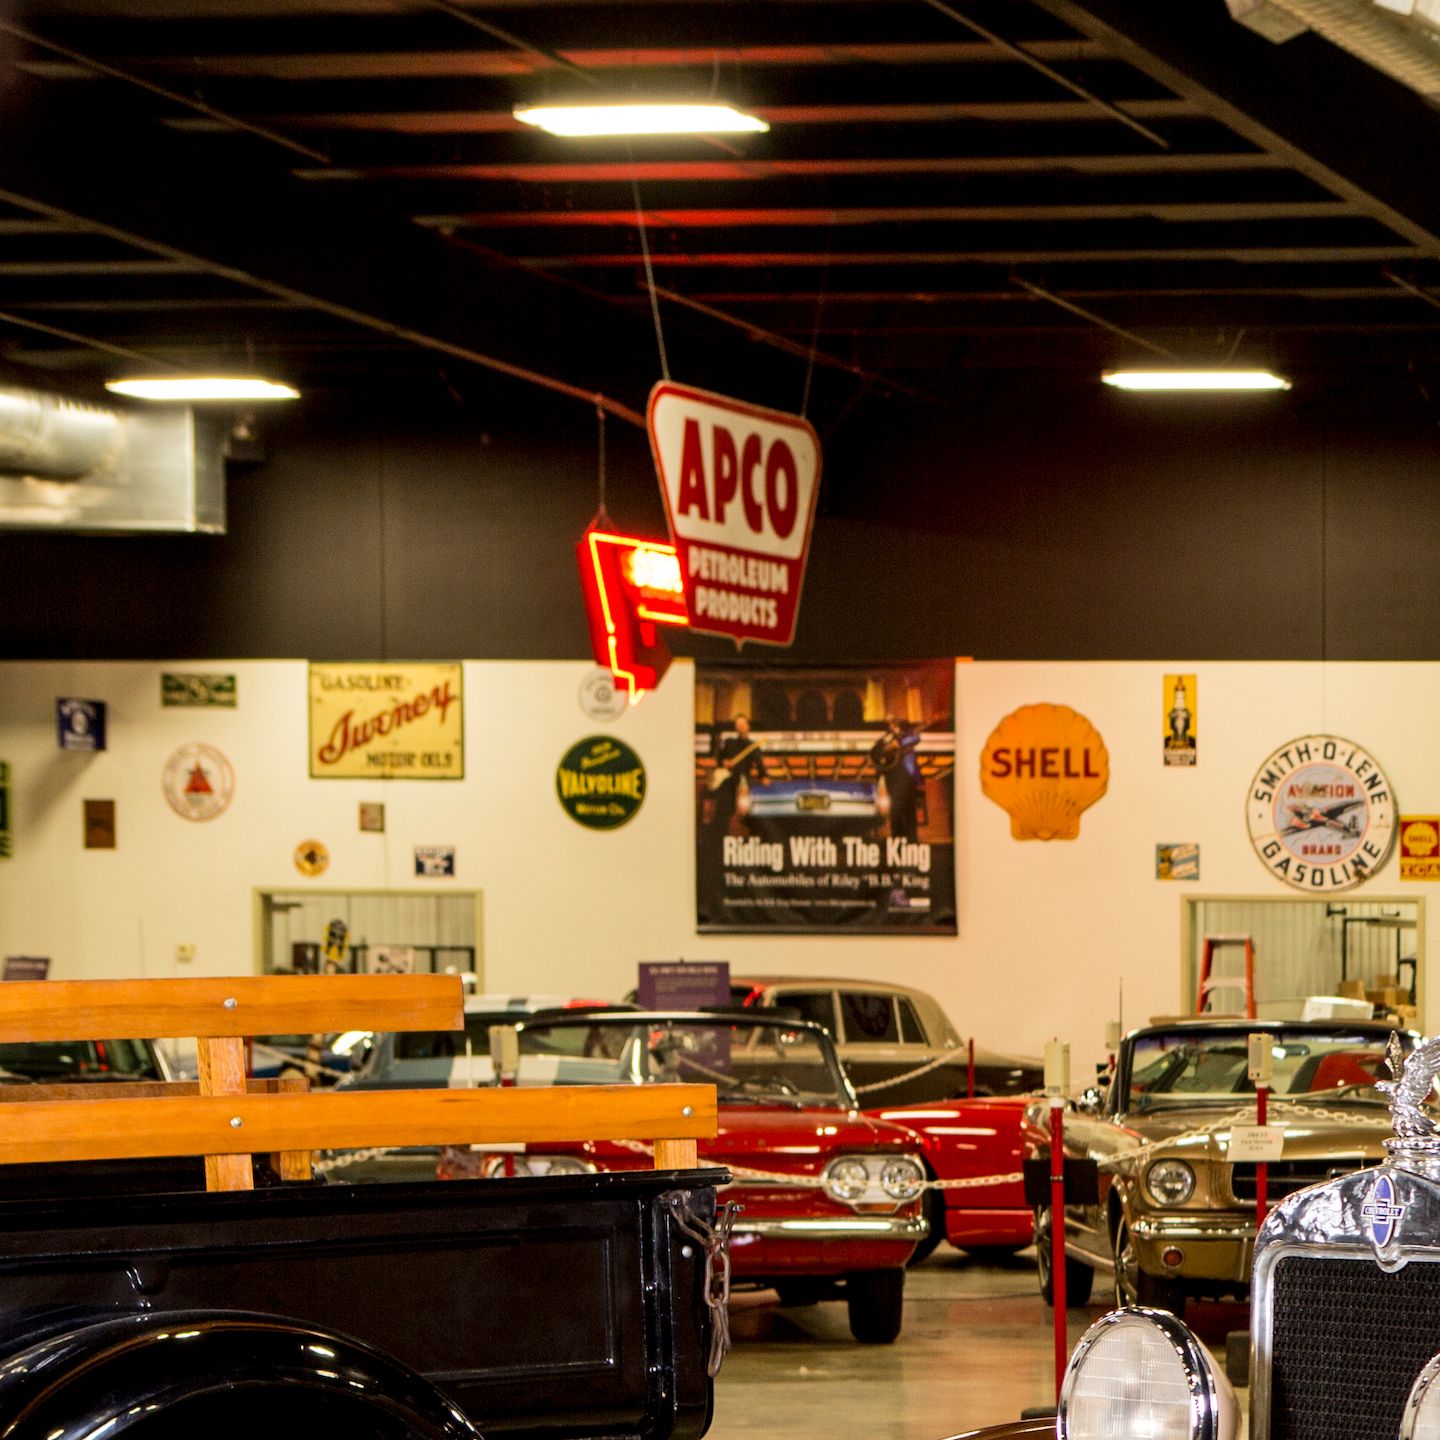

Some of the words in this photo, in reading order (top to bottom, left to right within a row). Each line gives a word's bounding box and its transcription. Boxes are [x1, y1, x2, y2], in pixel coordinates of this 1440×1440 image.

[678, 417, 798, 540] APCO
[688, 546, 788, 595] PETROLEUM
[695, 585, 778, 629] PRODUCTS
[321, 674, 404, 691] GASOLINE
[367, 752, 416, 768] MOTOR
[990, 747, 1099, 778] SHELL
[559, 767, 643, 800] VALVOLINE
[1287, 784, 1355, 799] AVTION
[723, 836, 784, 872] Riding
[789, 836, 837, 867] With
[843, 836, 880, 867] The
[886, 836, 931, 872] King
[1262, 841, 1381, 886] GASOLINE
[1302, 845, 1341, 856] BRAND
[724, 873, 744, 887] The
[902, 874, 930, 889] King
[1365, 1206, 1399, 1216] CHEVROLET
